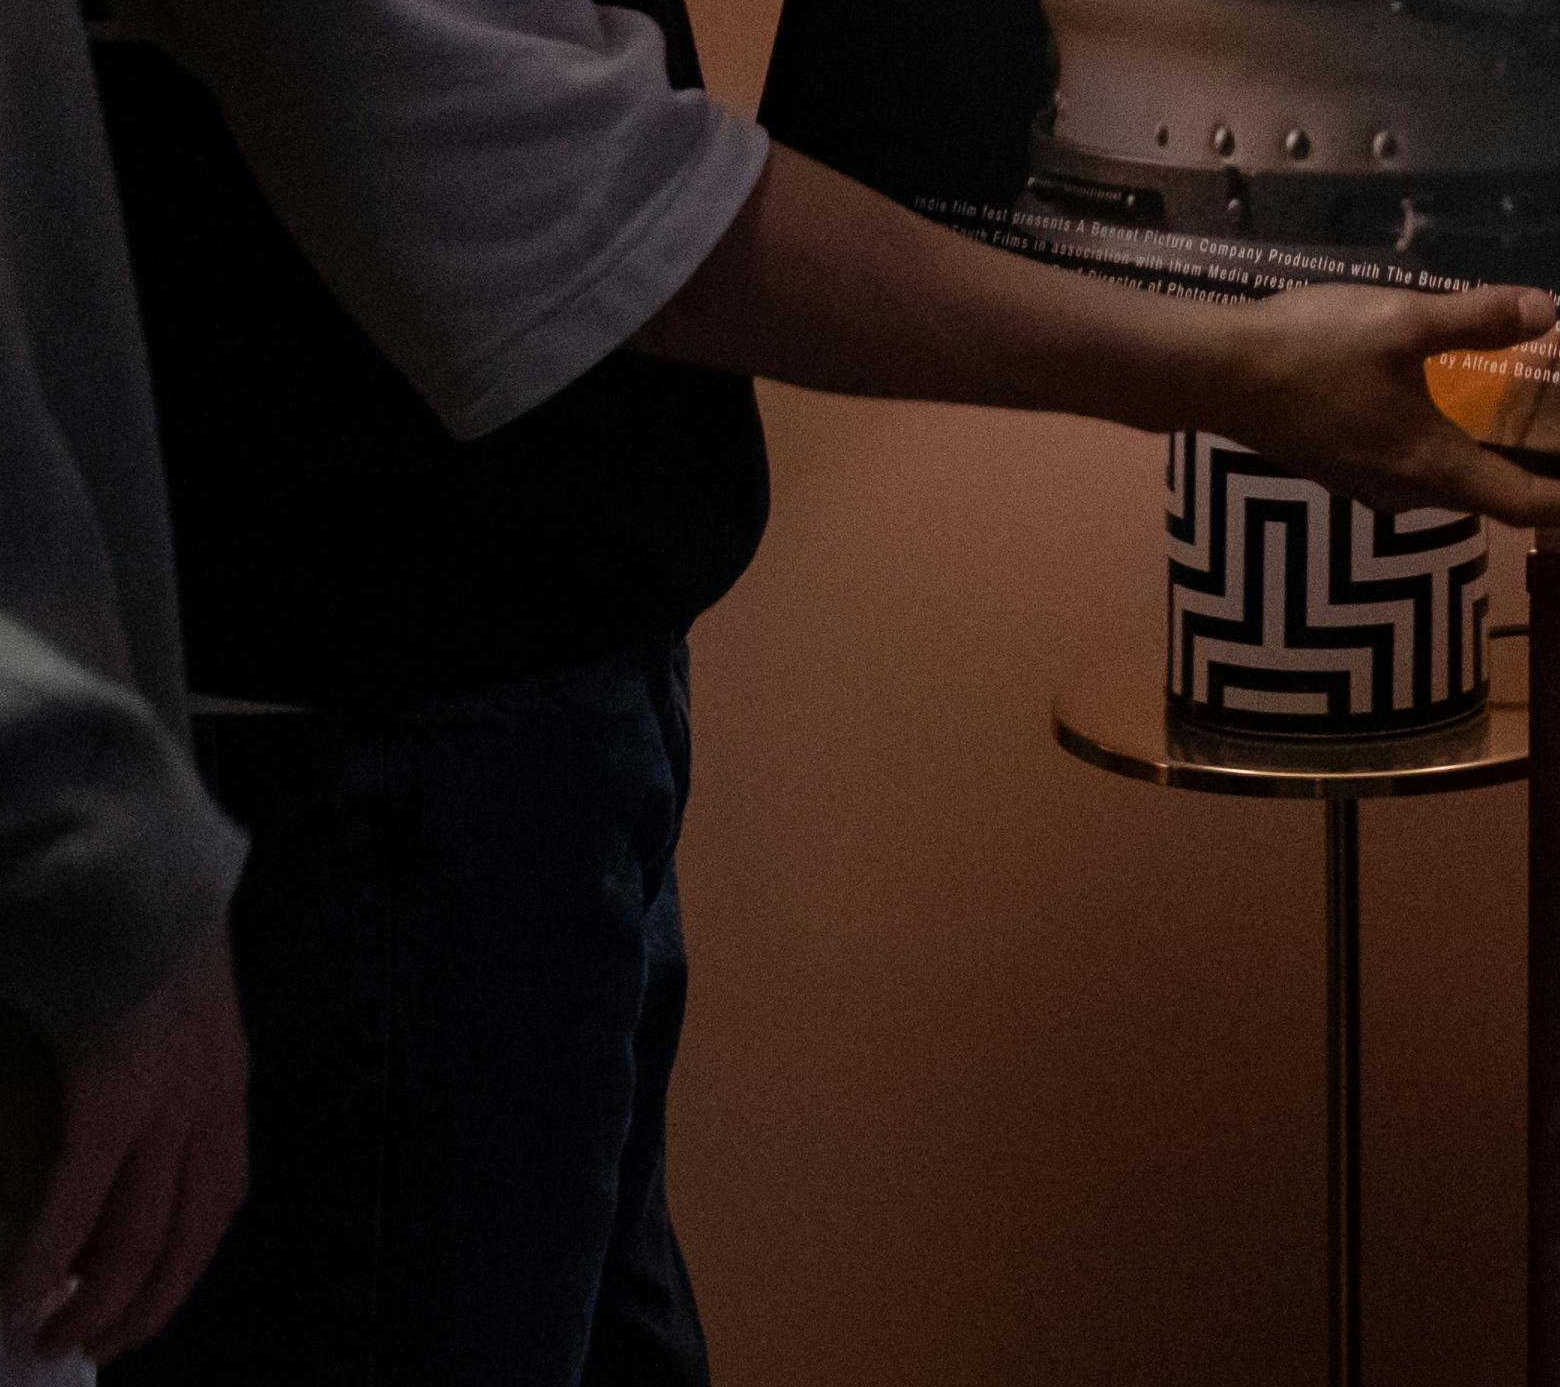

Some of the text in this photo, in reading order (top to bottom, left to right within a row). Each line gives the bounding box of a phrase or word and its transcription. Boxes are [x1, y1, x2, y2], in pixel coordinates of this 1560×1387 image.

[951, 199, 978, 217] film
[981, 204, 1009, 223] fest
[1011, 211, 1071, 233] presents
[1075, 219, 1086, 234] A
[1143, 228, 1193, 251] Picture
[1199, 238, 1263, 263] Company
[1268, 248, 1345, 274] Production
[1351, 261, 1381, 280] with
[1387, 265, 1413, 285] The
[1418, 270, 1470, 293] Bureau
[992, 230, 1028, 250] Films
[1033, 235, 1046, 252] in
[1050, 241, 1130, 264] association
[1134, 253, 1164, 270] with
[1168, 259, 1202, 276] them
[1207, 263, 1250, 283] Media
[1462, 353, 1509, 375] Alfred
[1514, 361, 1560, 384] Boone
